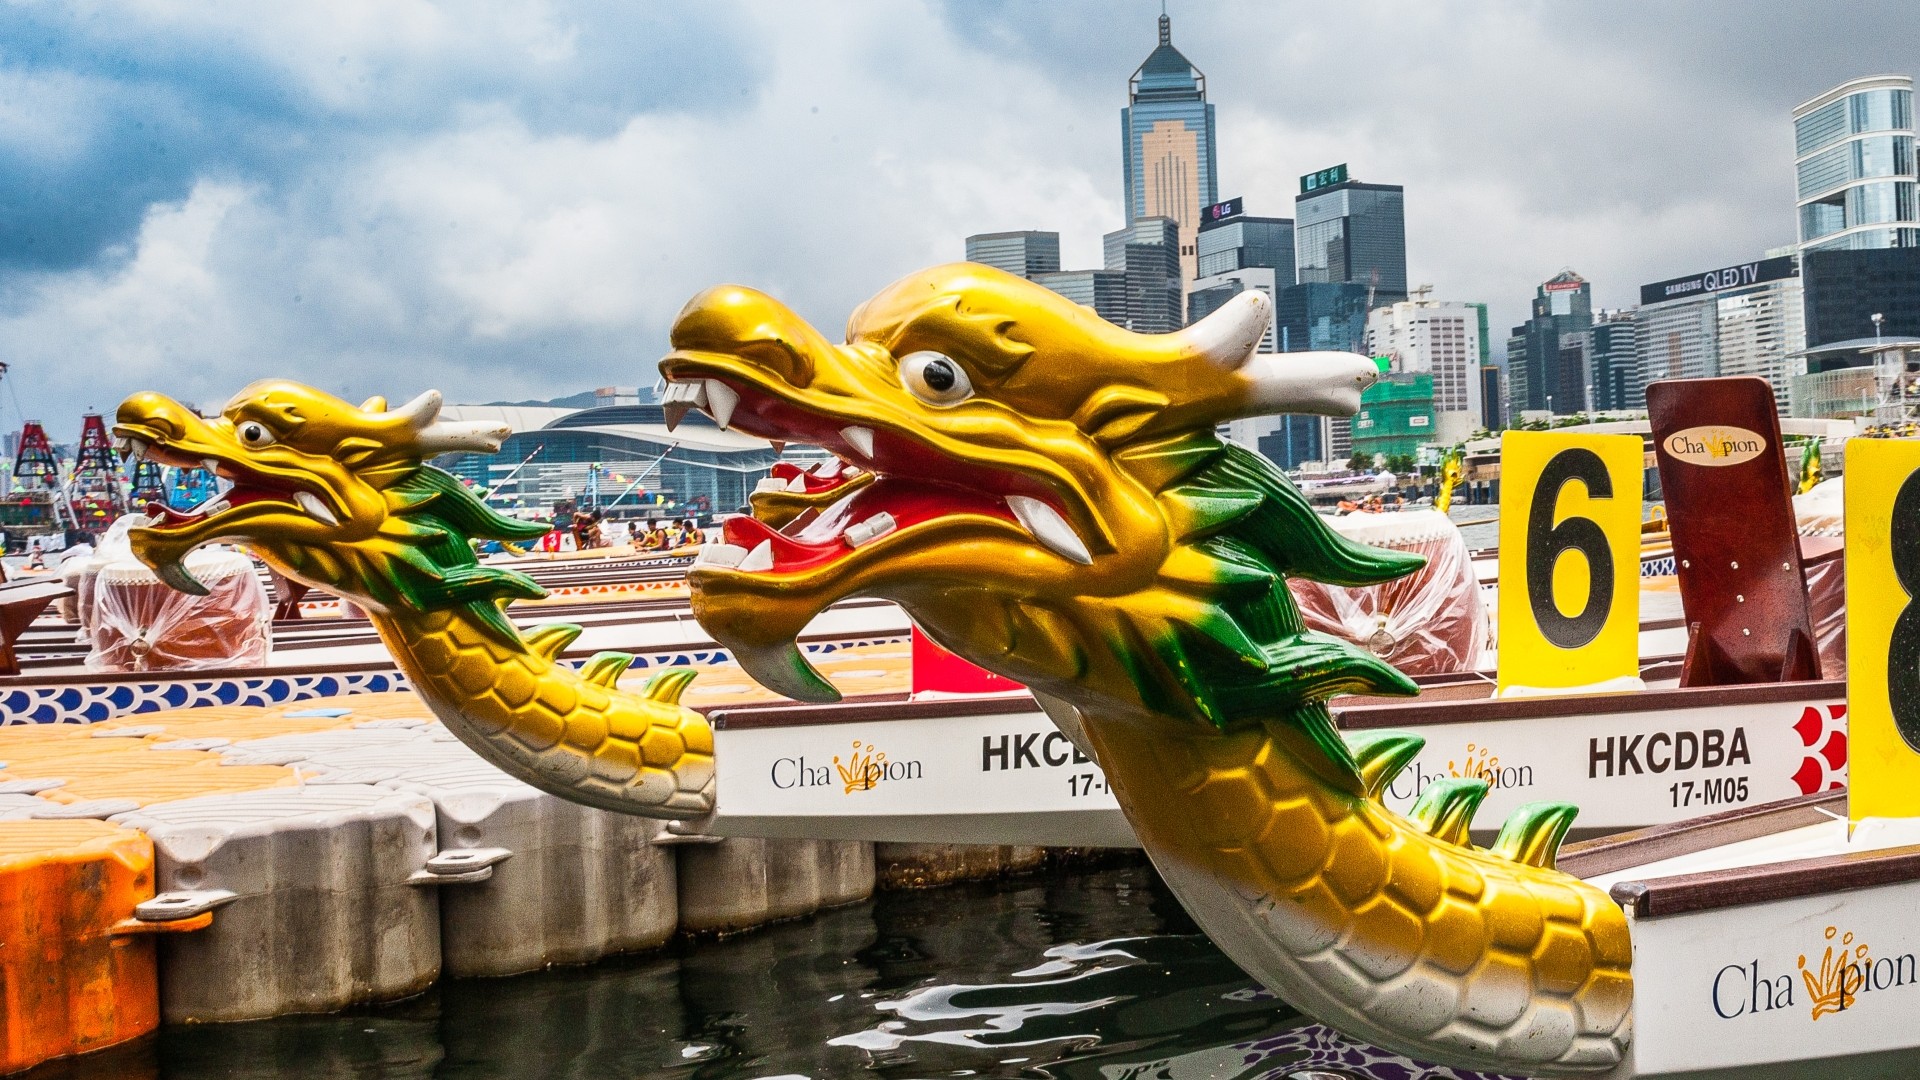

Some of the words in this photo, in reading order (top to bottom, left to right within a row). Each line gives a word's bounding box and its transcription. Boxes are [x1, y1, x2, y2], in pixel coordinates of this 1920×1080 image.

[1221, 203, 1231, 216] LG
[1665, 279, 1702, 296] SAMSUNG
[1703, 267, 1740, 292] QLED
[1740, 262, 1759, 284] TV
[1526, 447, 1615, 649] 6
[1588, 726, 1752, 779] HKCDBA
[1669, 776, 1749, 808] 17-M05
